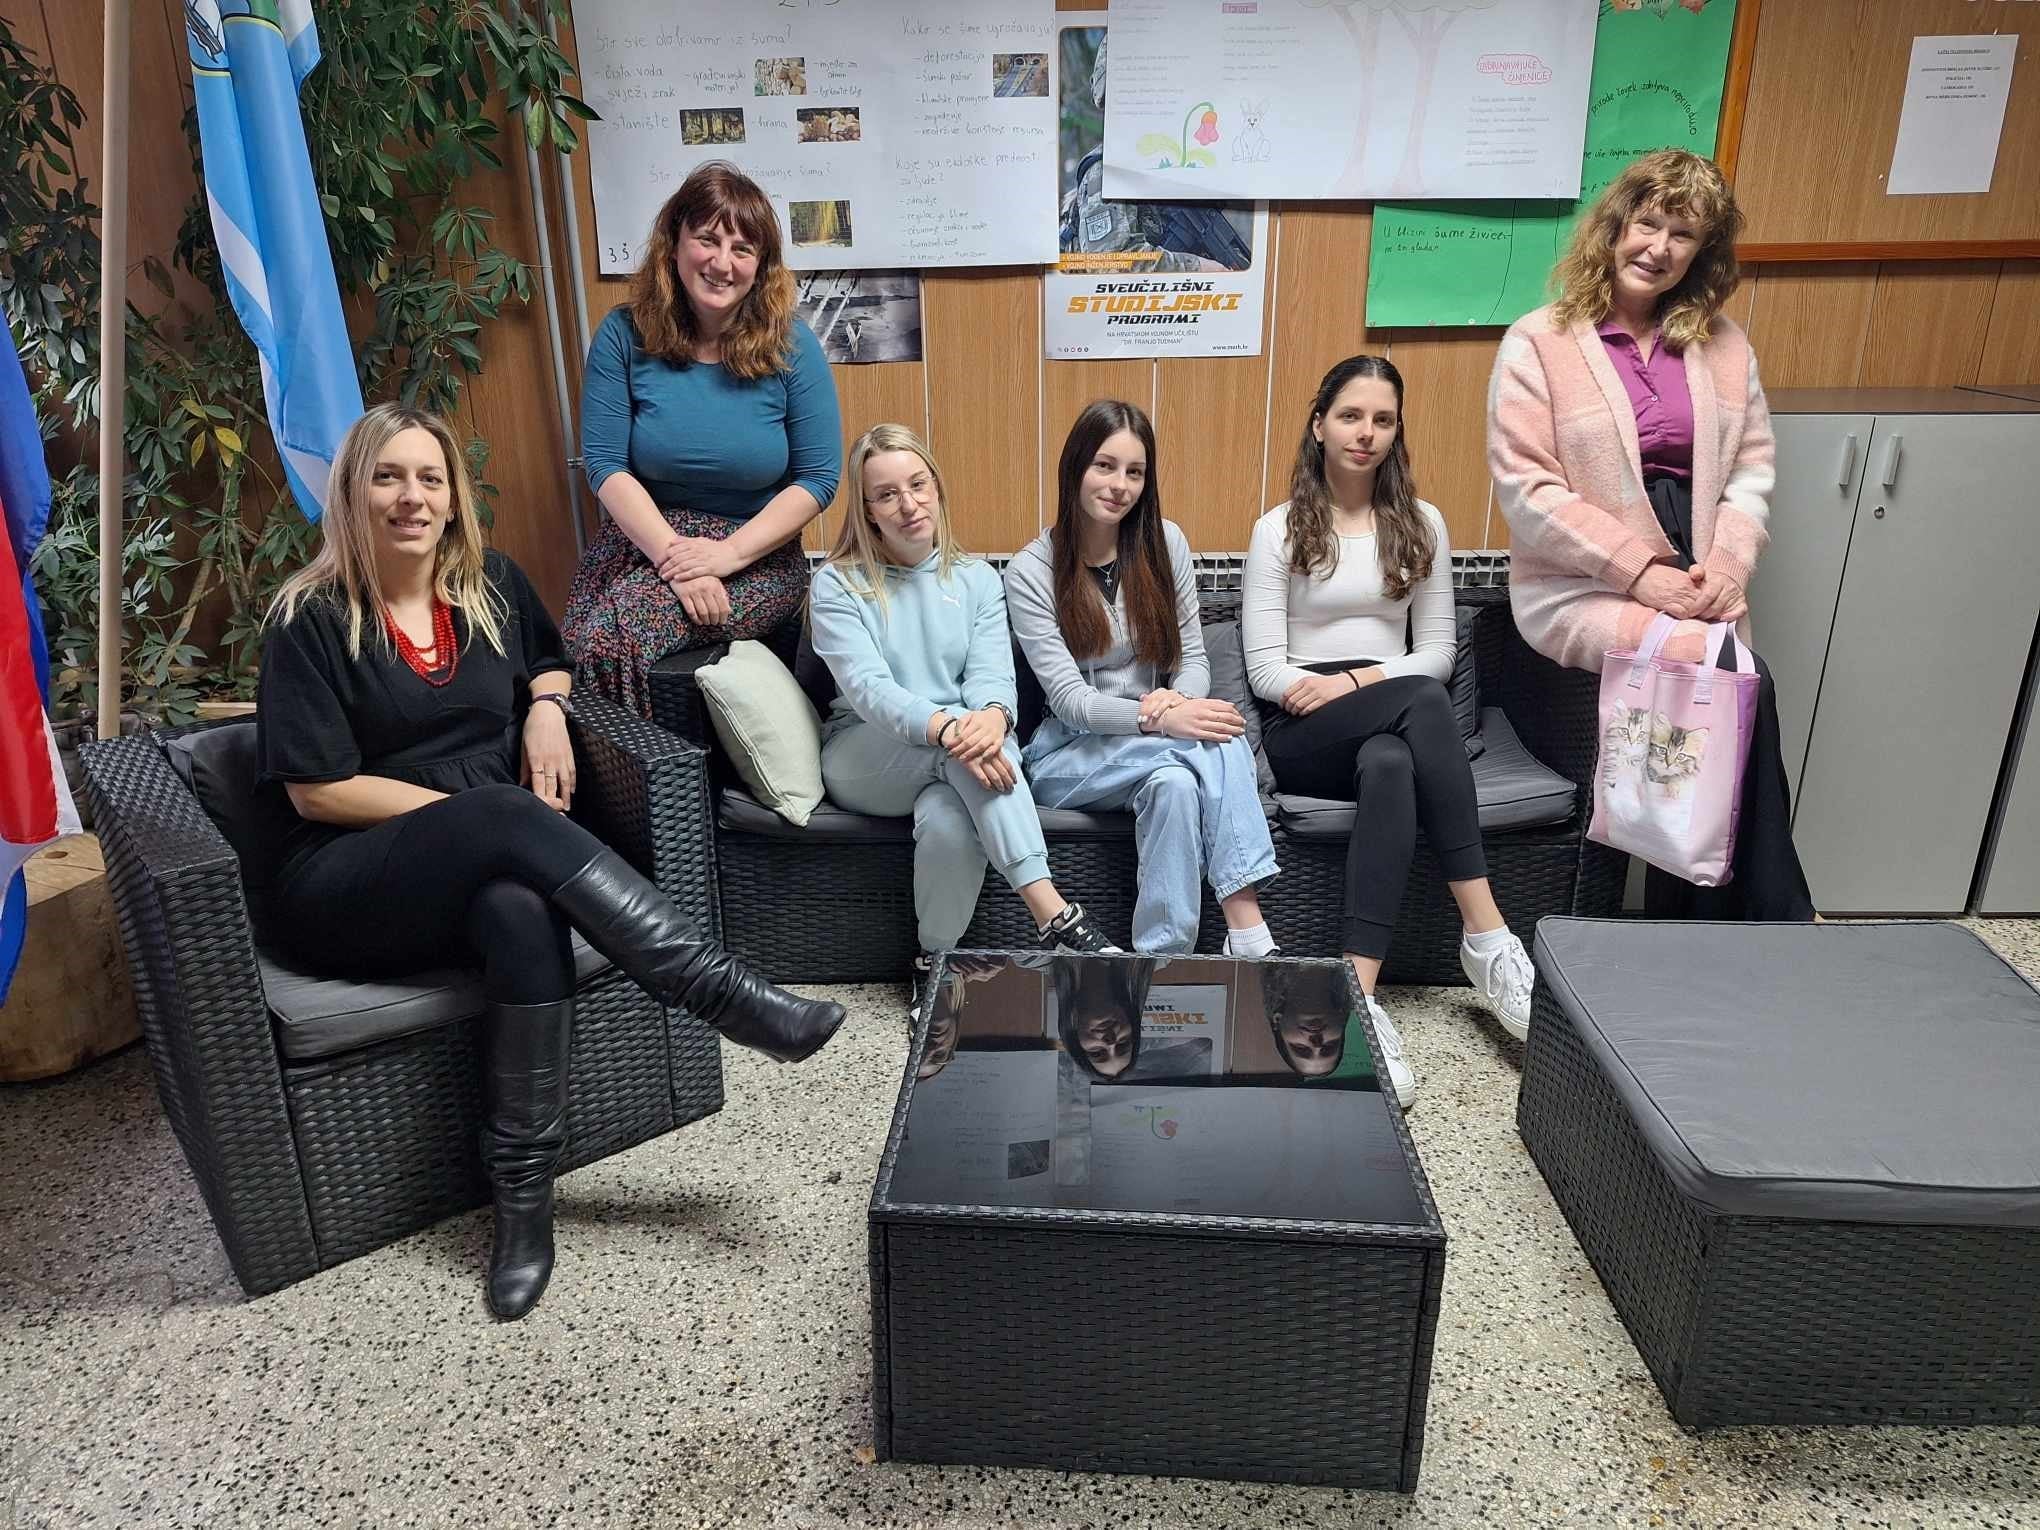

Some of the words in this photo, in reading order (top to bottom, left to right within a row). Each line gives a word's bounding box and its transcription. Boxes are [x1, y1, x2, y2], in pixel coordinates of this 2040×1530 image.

[1095, 277, 1215, 294] SVEUČILIŠNI
[1067, 293, 1244, 314] STUDIJSKI
[1107, 313, 1202, 325] PROGRAMI
